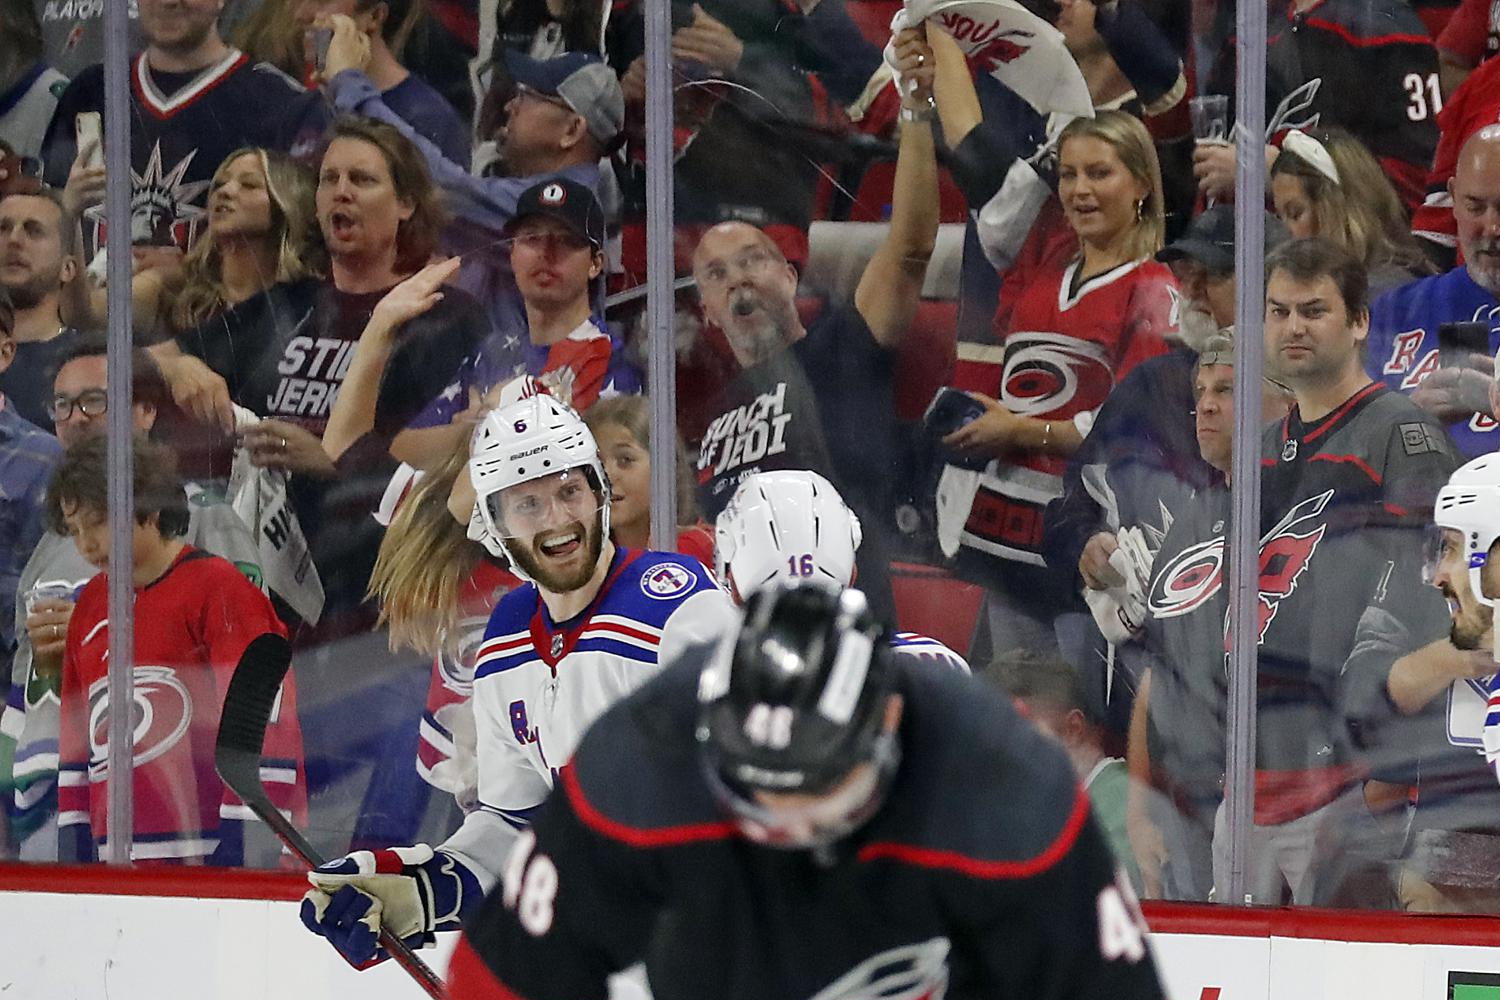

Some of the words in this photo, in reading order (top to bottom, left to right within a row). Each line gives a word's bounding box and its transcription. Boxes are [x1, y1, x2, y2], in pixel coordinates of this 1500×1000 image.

[1403, 72, 1443, 121] 31
[514, 419, 527, 433] 6
[788, 554, 814, 577] 16
